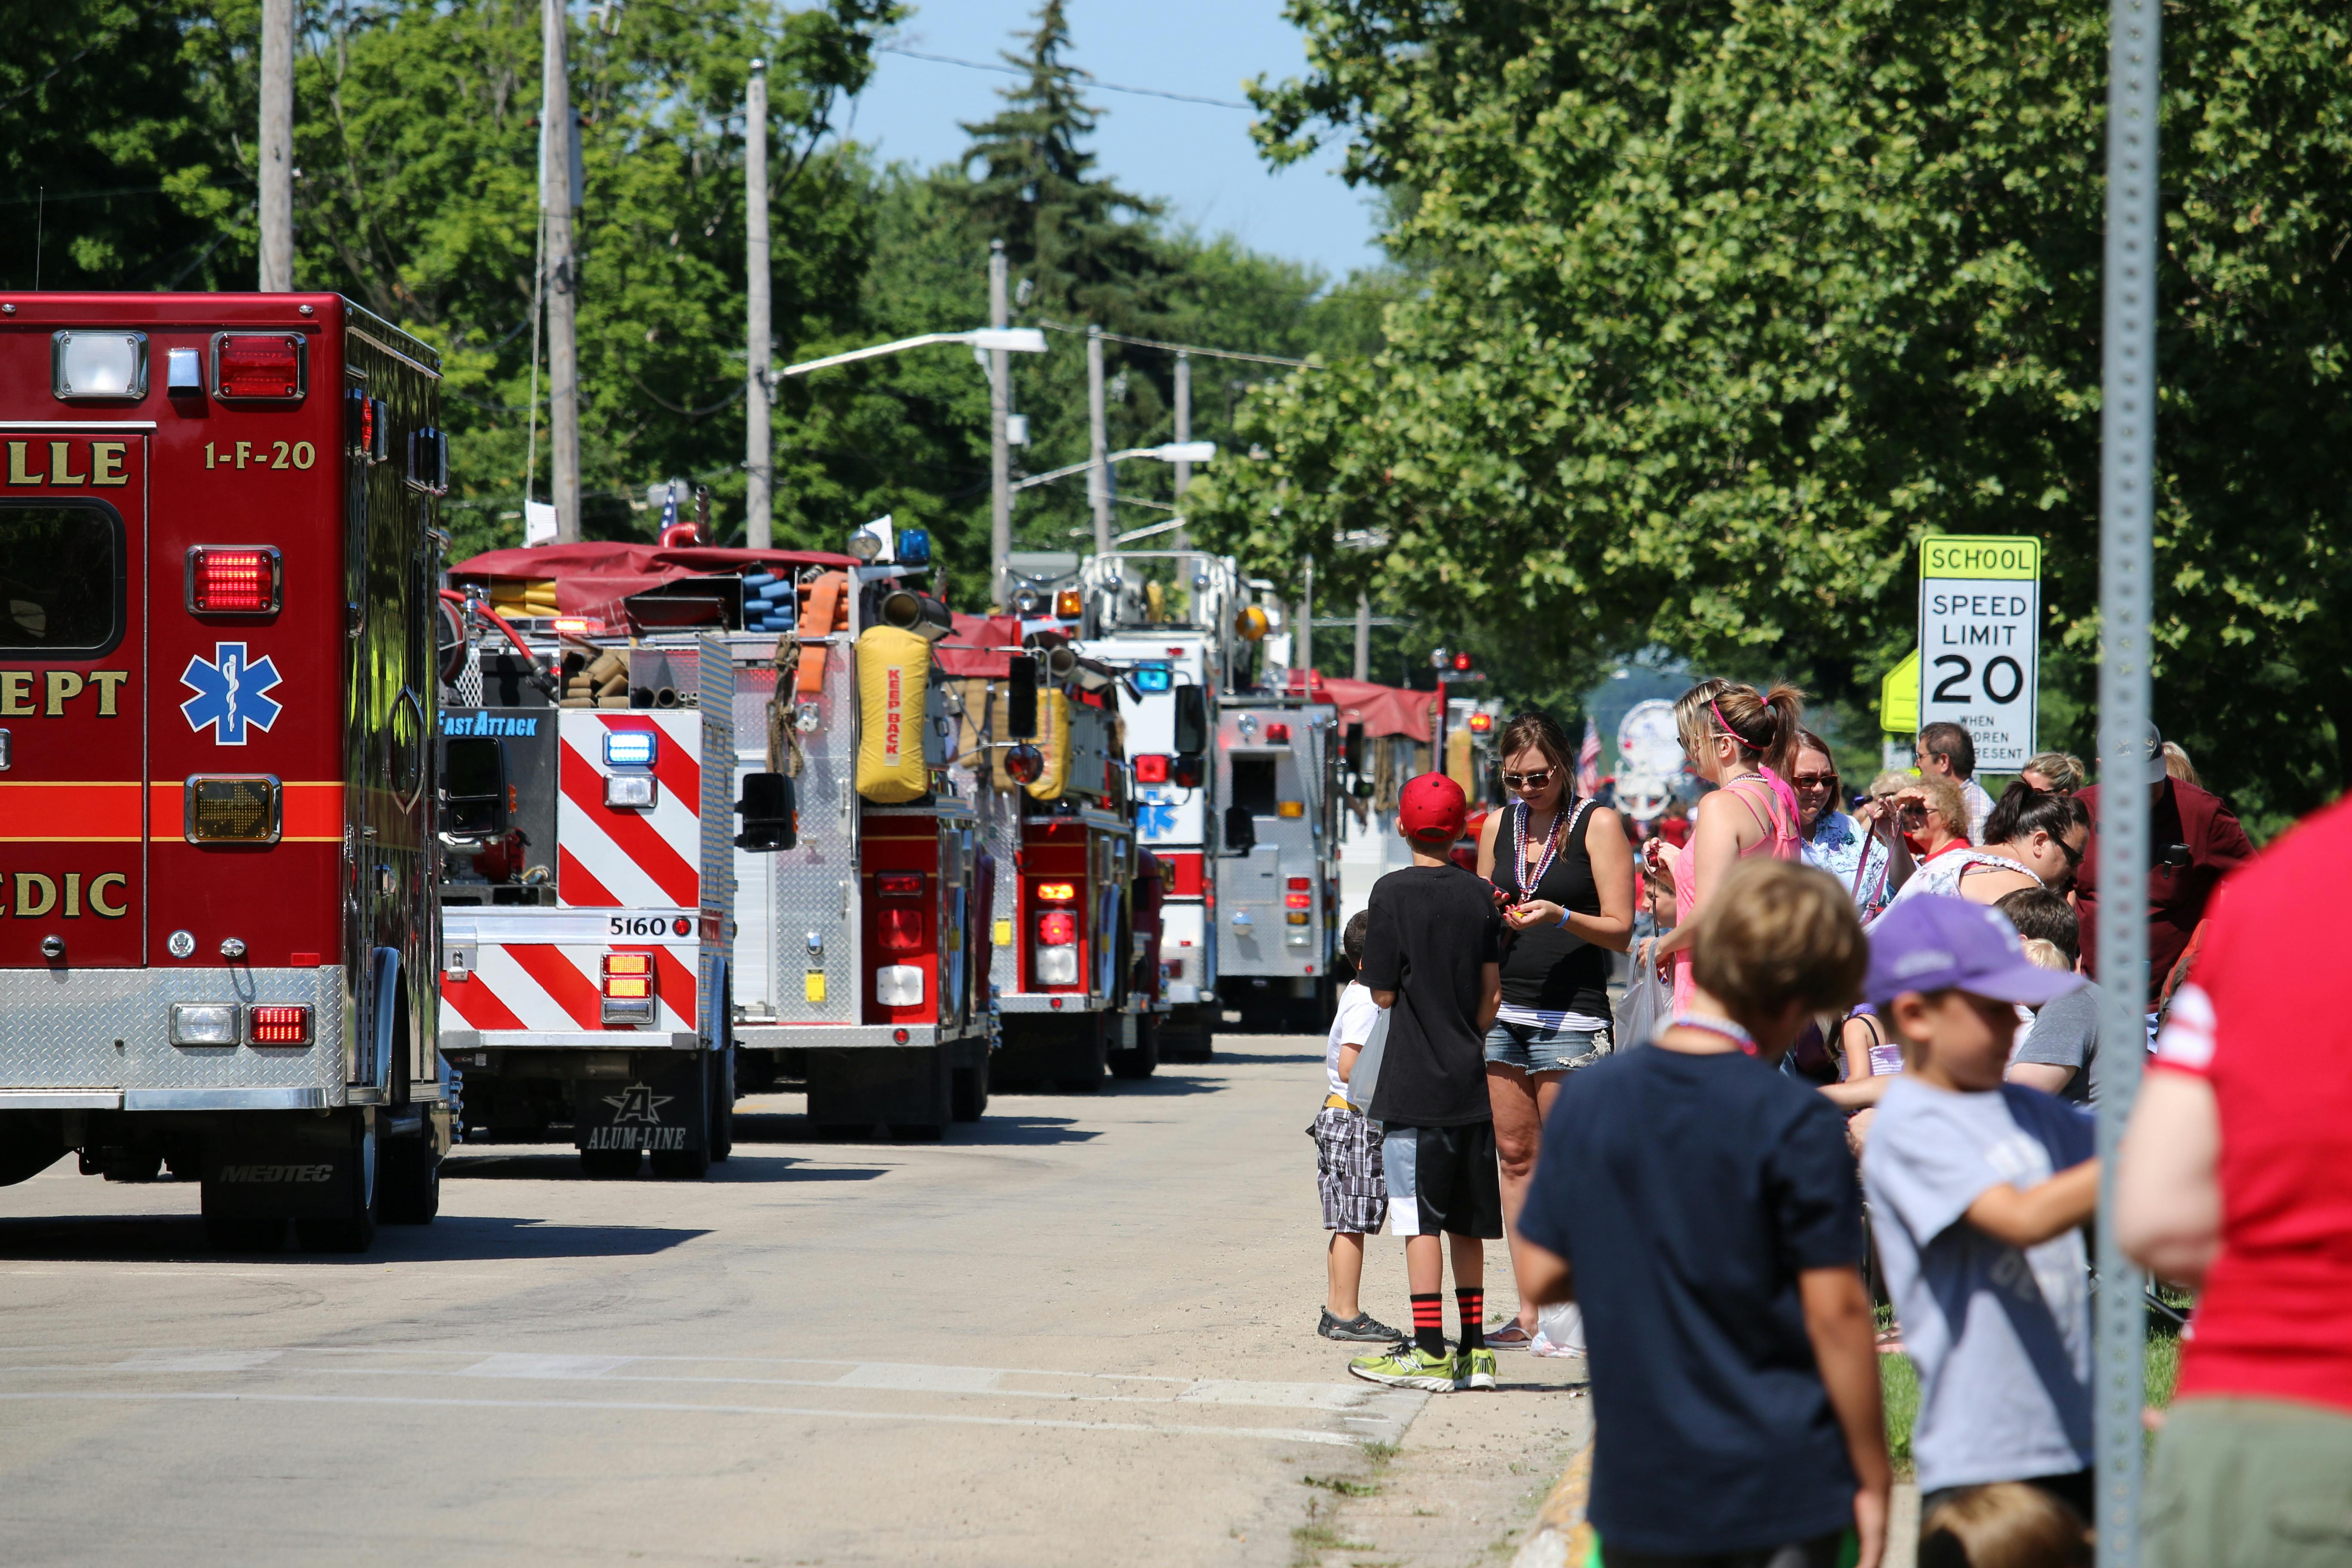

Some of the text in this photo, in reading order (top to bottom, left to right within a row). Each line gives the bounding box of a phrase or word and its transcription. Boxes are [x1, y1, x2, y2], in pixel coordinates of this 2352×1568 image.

[204, 441, 316, 469] 1-F-20
[1932, 548, 2030, 570] SCHOOL
[1933, 595, 2026, 616] SPEED
[1943, 625, 2017, 646] LIMIT
[888, 669, 900, 710] KEEP
[1932, 654, 2024, 704] 20
[1960, 715, 1994, 727] WHEN
[885, 713, 900, 754] BACK
[1973, 732, 2009, 743] DREN
[1974, 748, 2023, 760] RESENT
[0, 873, 128, 917] DIC
[610, 918, 666, 936] 5160
[587, 1126, 686, 1150] ALUM-LINE
[220, 1164, 334, 1182] MEDTEC
